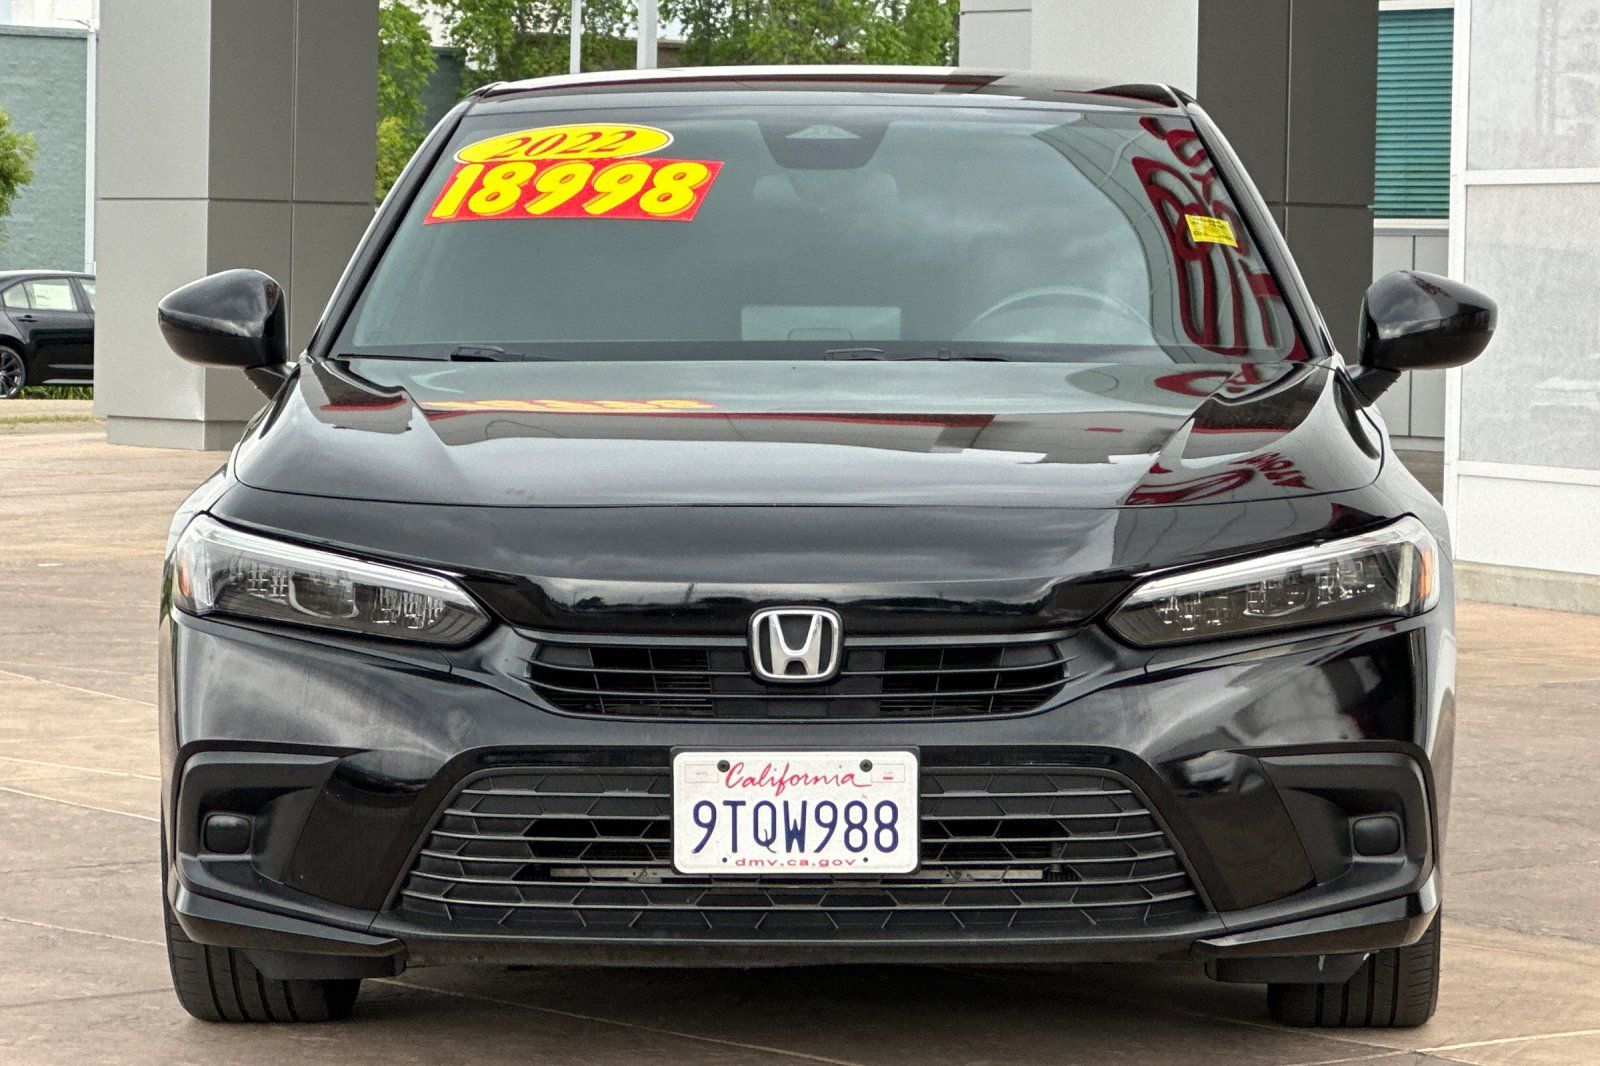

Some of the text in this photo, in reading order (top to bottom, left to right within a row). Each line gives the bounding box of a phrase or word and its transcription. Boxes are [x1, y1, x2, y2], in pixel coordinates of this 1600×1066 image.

[484, 129, 637, 160] 2022
[431, 160, 711, 218] 18998
[724, 762, 873, 797] California
[692, 800, 899, 854] 9TQW988
[734, 857, 856, 868] dmv.ca.gov
